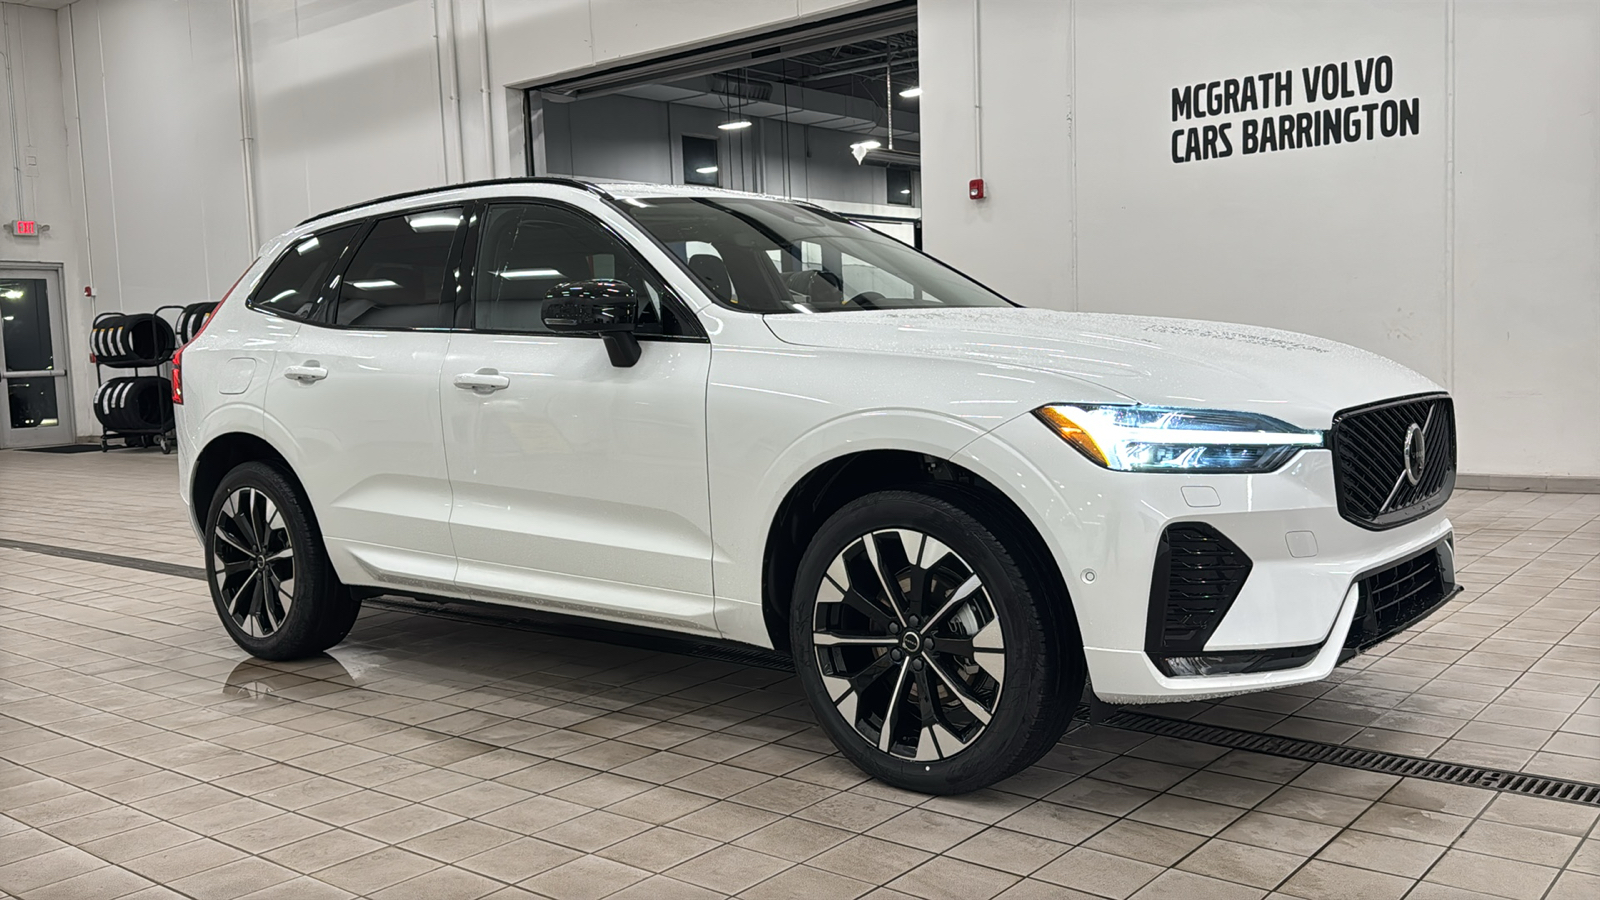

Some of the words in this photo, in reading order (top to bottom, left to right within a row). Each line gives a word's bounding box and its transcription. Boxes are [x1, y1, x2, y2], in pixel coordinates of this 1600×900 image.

[1171, 69, 1293, 122] MCGRATH
[1302, 55, 1393, 103] VOLVO
[1171, 122, 1233, 164] CARS
[1242, 97, 1420, 155] BARRINGTON
[17, 221, 35, 234] EXIT
